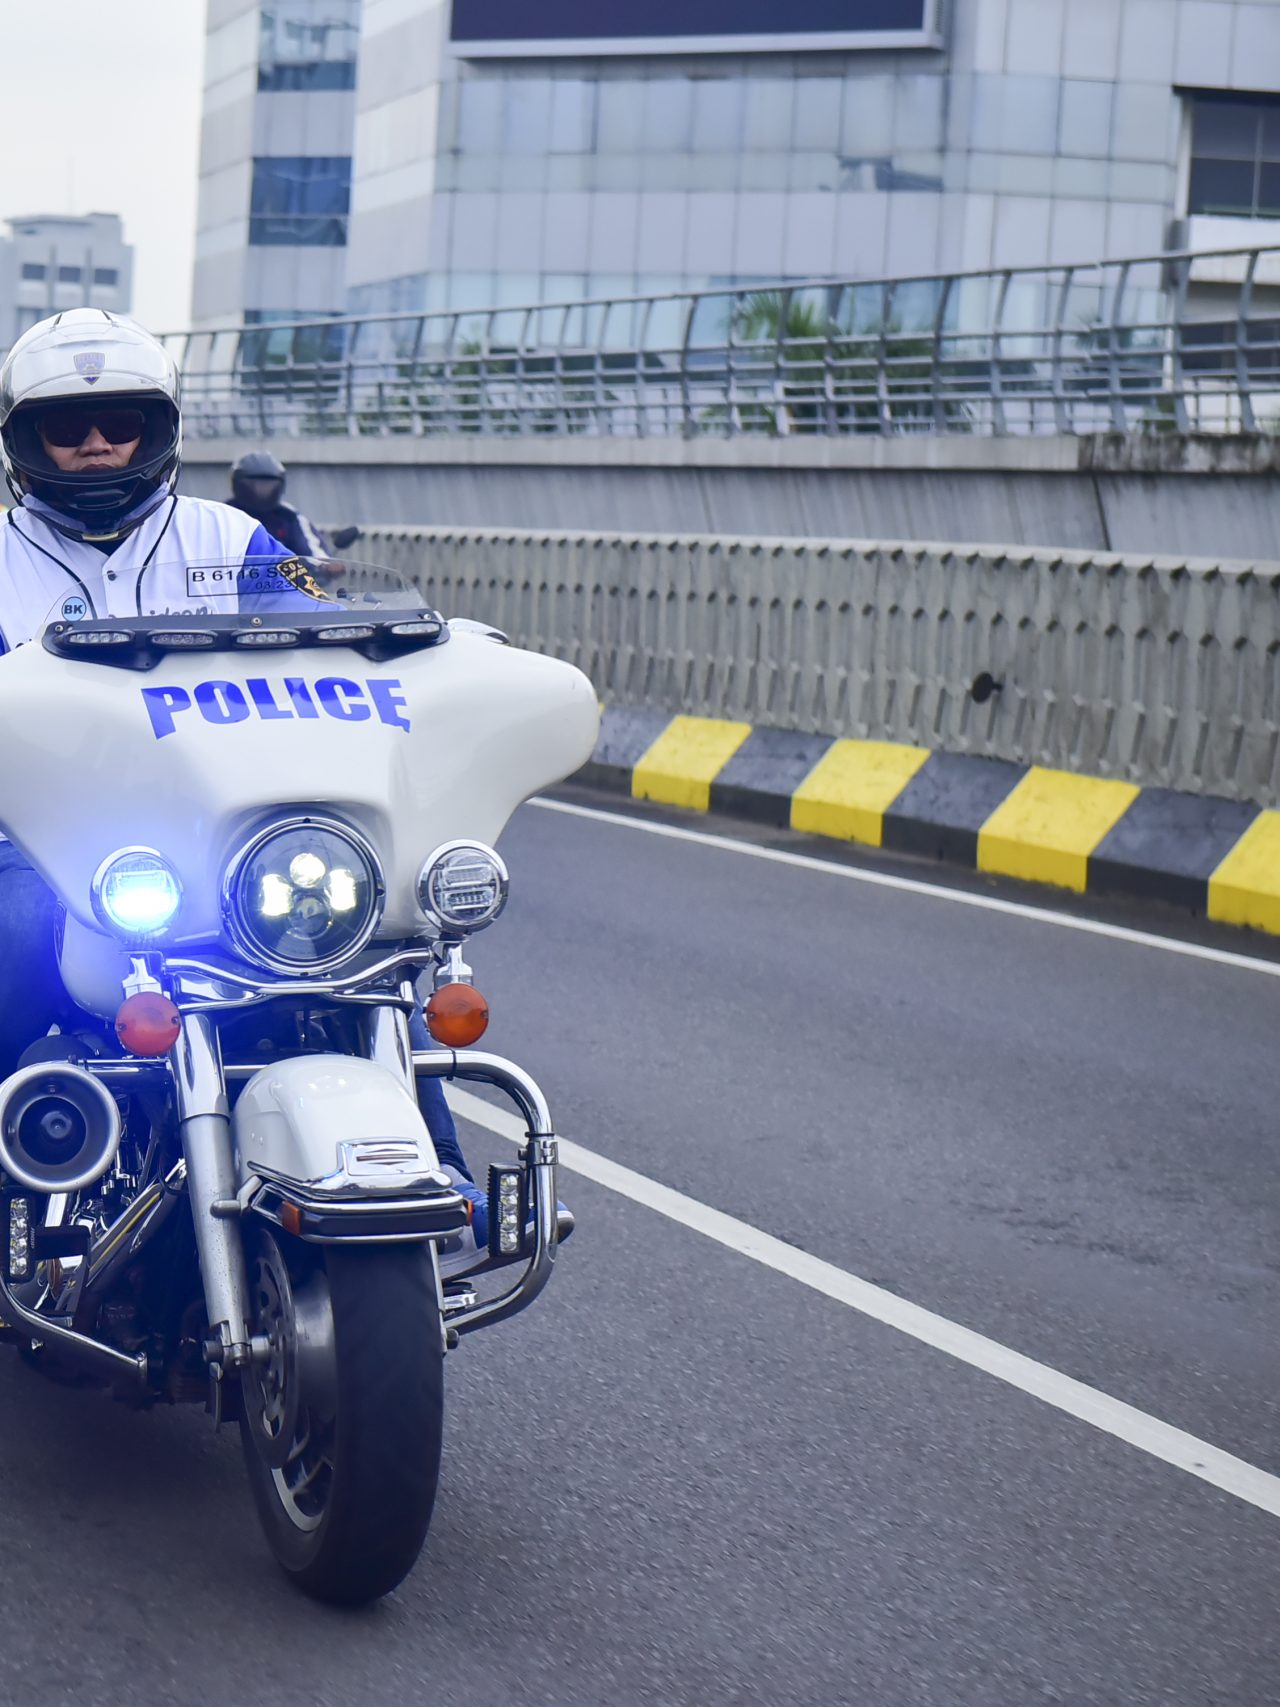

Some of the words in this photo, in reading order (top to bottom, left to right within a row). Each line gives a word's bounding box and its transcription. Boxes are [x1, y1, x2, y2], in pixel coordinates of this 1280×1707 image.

[192, 571, 205, 582] B
[212, 569, 260, 581] 6116
[63, 604, 84, 615] BK
[141, 677, 411, 740] POLICE
